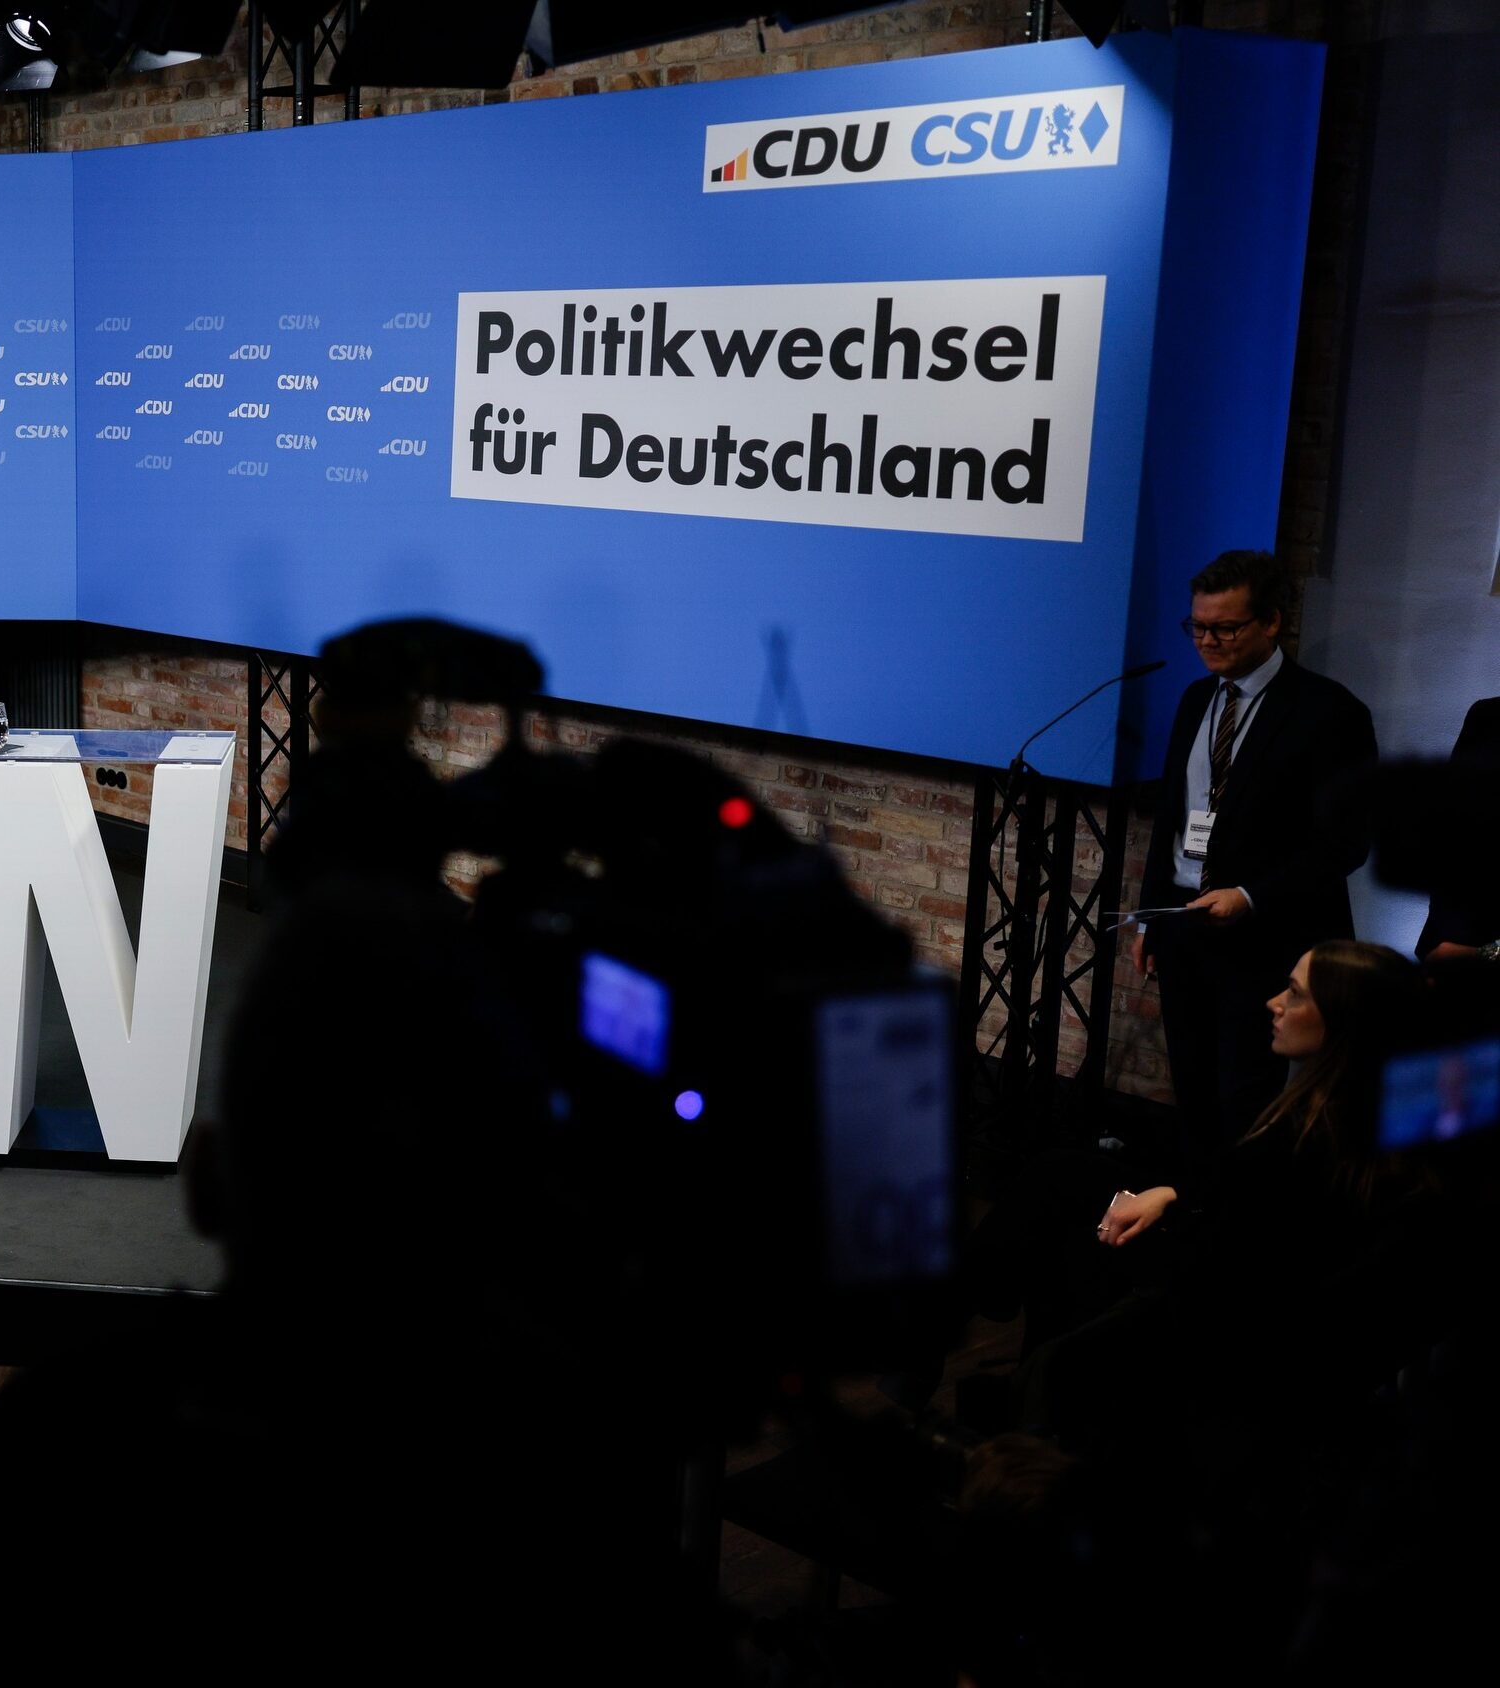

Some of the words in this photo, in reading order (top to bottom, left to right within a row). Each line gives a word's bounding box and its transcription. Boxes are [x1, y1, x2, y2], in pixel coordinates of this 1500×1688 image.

[752, 121, 890, 179] CDU
[910, 109, 1041, 167] CSU
[13, 319, 51, 334] CSU
[103, 317, 132, 332] CDU
[194, 315, 225, 331] CDU
[278, 314, 305, 330] CSU
[395, 312, 432, 329] CDU
[476, 293, 1061, 383] Politikwechsel
[144, 344, 173, 360] CDU
[239, 344, 271, 360] CDU
[328, 344, 357, 361] CSU
[14, 372, 52, 386] CSU
[103, 371, 132, 386] CDU
[193, 373, 225, 389] CDU
[277, 374, 305, 391] CSU
[392, 376, 429, 393] CDU
[143, 399, 173, 415] CDU
[238, 403, 270, 419] CDU
[326, 405, 356, 422] CSU
[15, 424, 52, 439] CSU
[103, 425, 131, 441] CDU
[193, 429, 224, 446] CDU
[275, 433, 304, 450] CSU
[390, 438, 427, 456] CDU
[469, 402, 557, 476] für
[578, 412, 1051, 505] Deutschland
[143, 454, 173, 471] CDU
[237, 460, 269, 477] CDU
[325, 466, 354, 483] CSU
